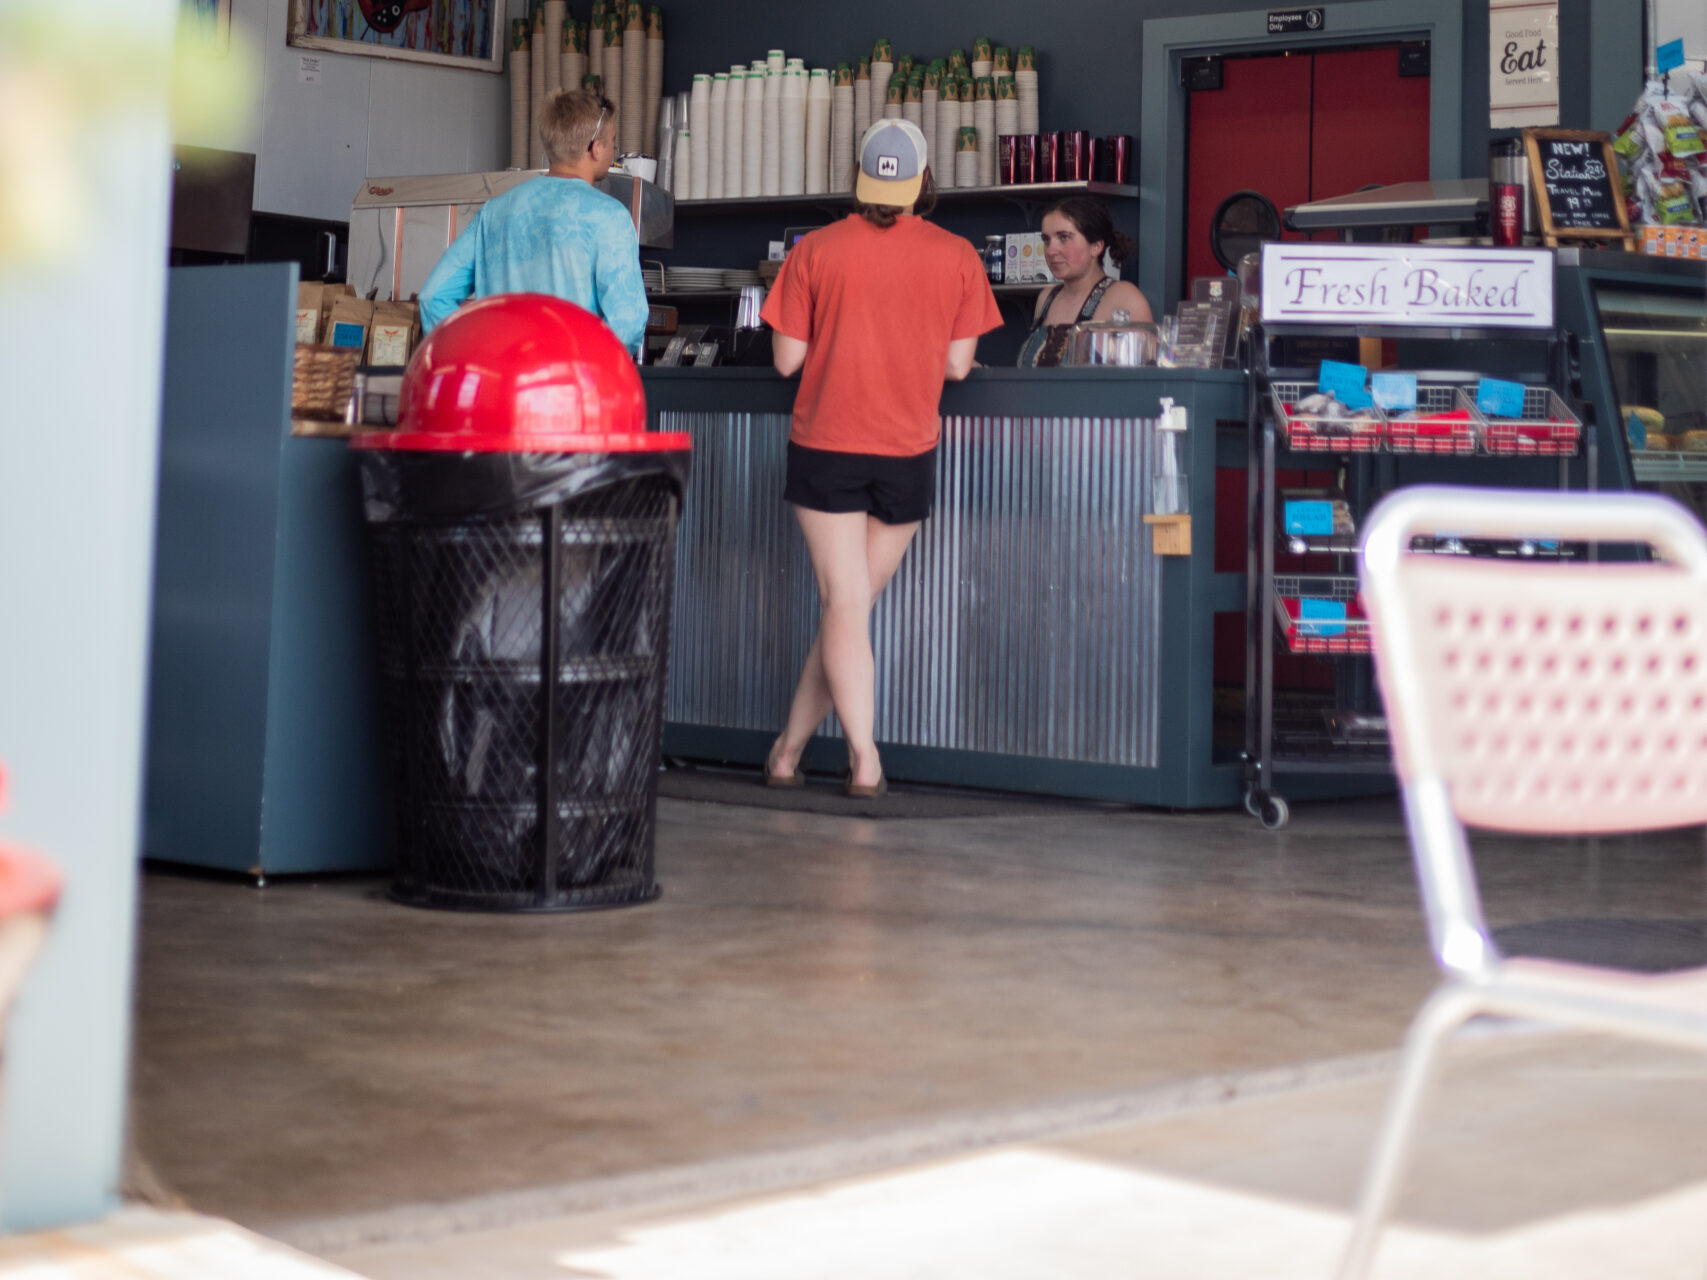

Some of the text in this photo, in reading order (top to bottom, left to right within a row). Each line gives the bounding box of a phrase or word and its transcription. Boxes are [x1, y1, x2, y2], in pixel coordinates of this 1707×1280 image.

[1269, 14, 1302, 23] Employees
[1269, 23, 1284, 31] Only
[1505, 28, 1542, 39] Good Food
[1500, 37, 1547, 75] Eat
[1552, 142, 1591, 157] NEW!
[1546, 158, 1591, 180] Station
[1284, 266, 1529, 308] Fresh Baked
